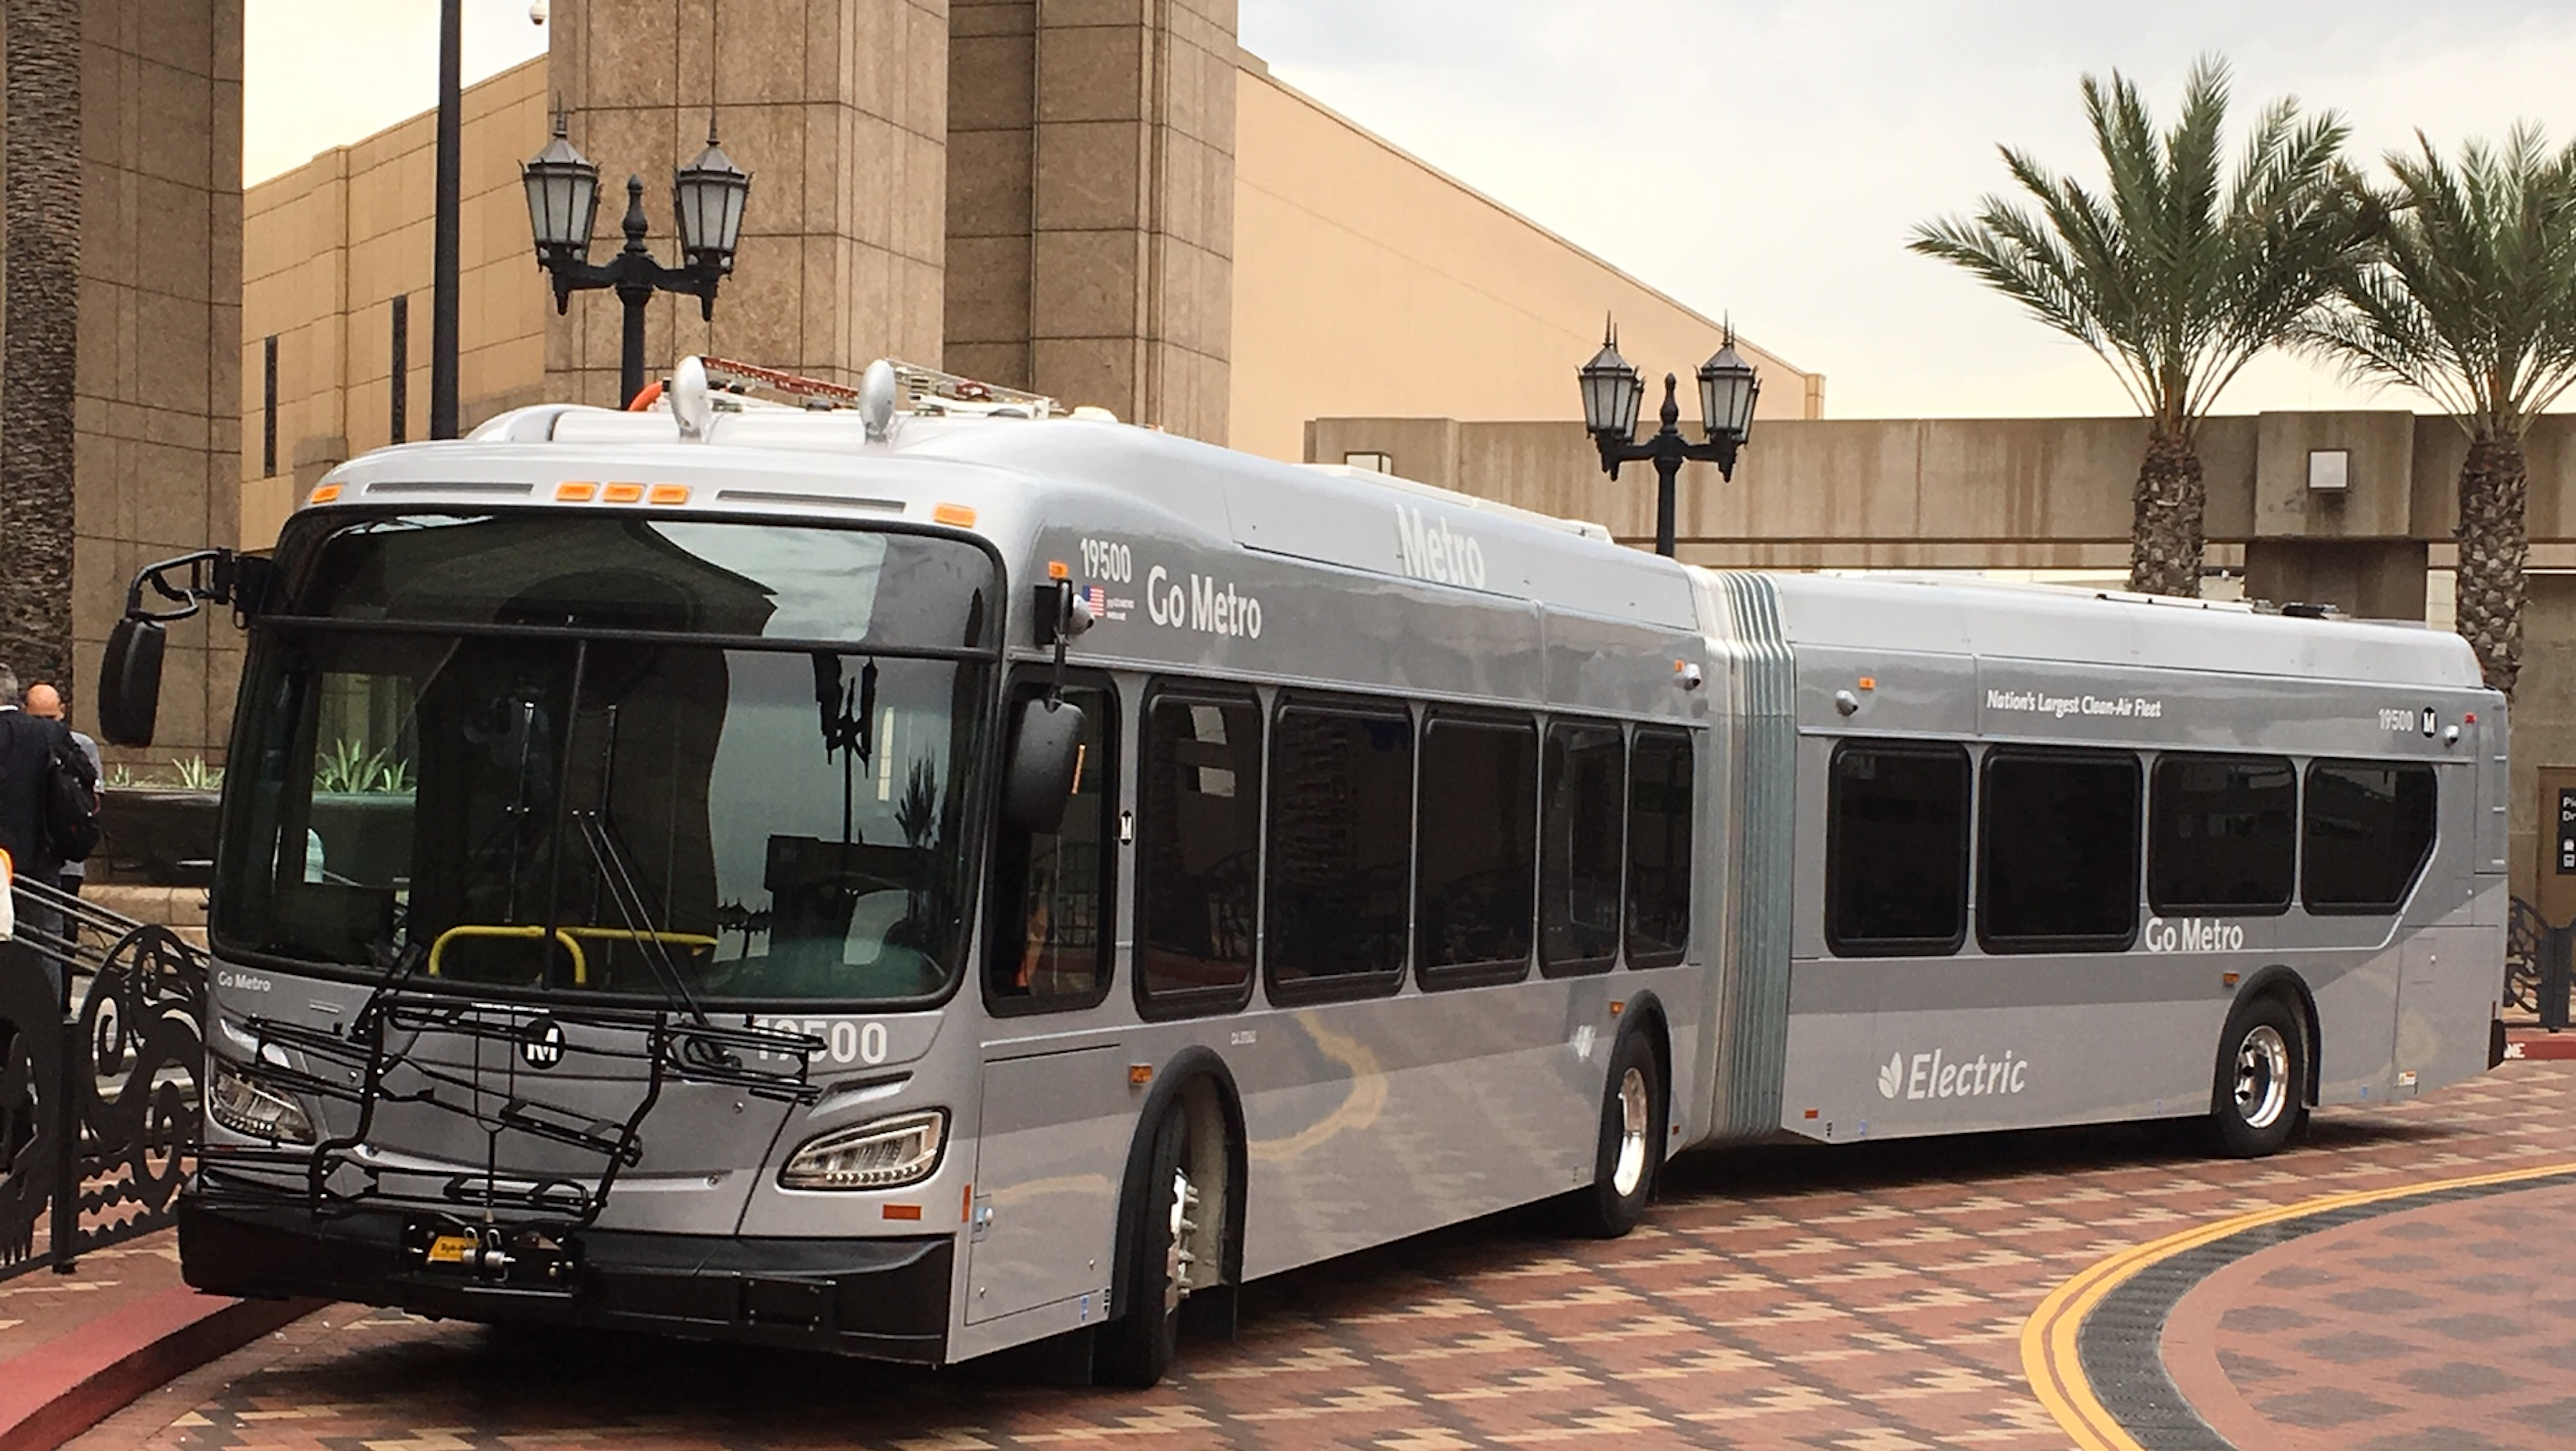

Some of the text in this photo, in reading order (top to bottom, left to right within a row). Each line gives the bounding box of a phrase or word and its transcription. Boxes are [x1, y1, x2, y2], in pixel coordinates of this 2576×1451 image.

[1080, 537, 1131, 584] 19500
[1395, 502, 1486, 590] Metro
[1147, 564, 1262, 639] Go Metro
[1986, 689, 2161, 718] Nation's Largest Clean-Air Fleet
[2378, 708, 2415, 732] 19500
[2422, 712, 2436, 734] M
[1121, 816, 1132, 839] M
[2145, 917, 2244, 953] Go Metro
[218, 971, 271, 992] Go Metro
[1907, 1048, 2028, 1100] Electric
